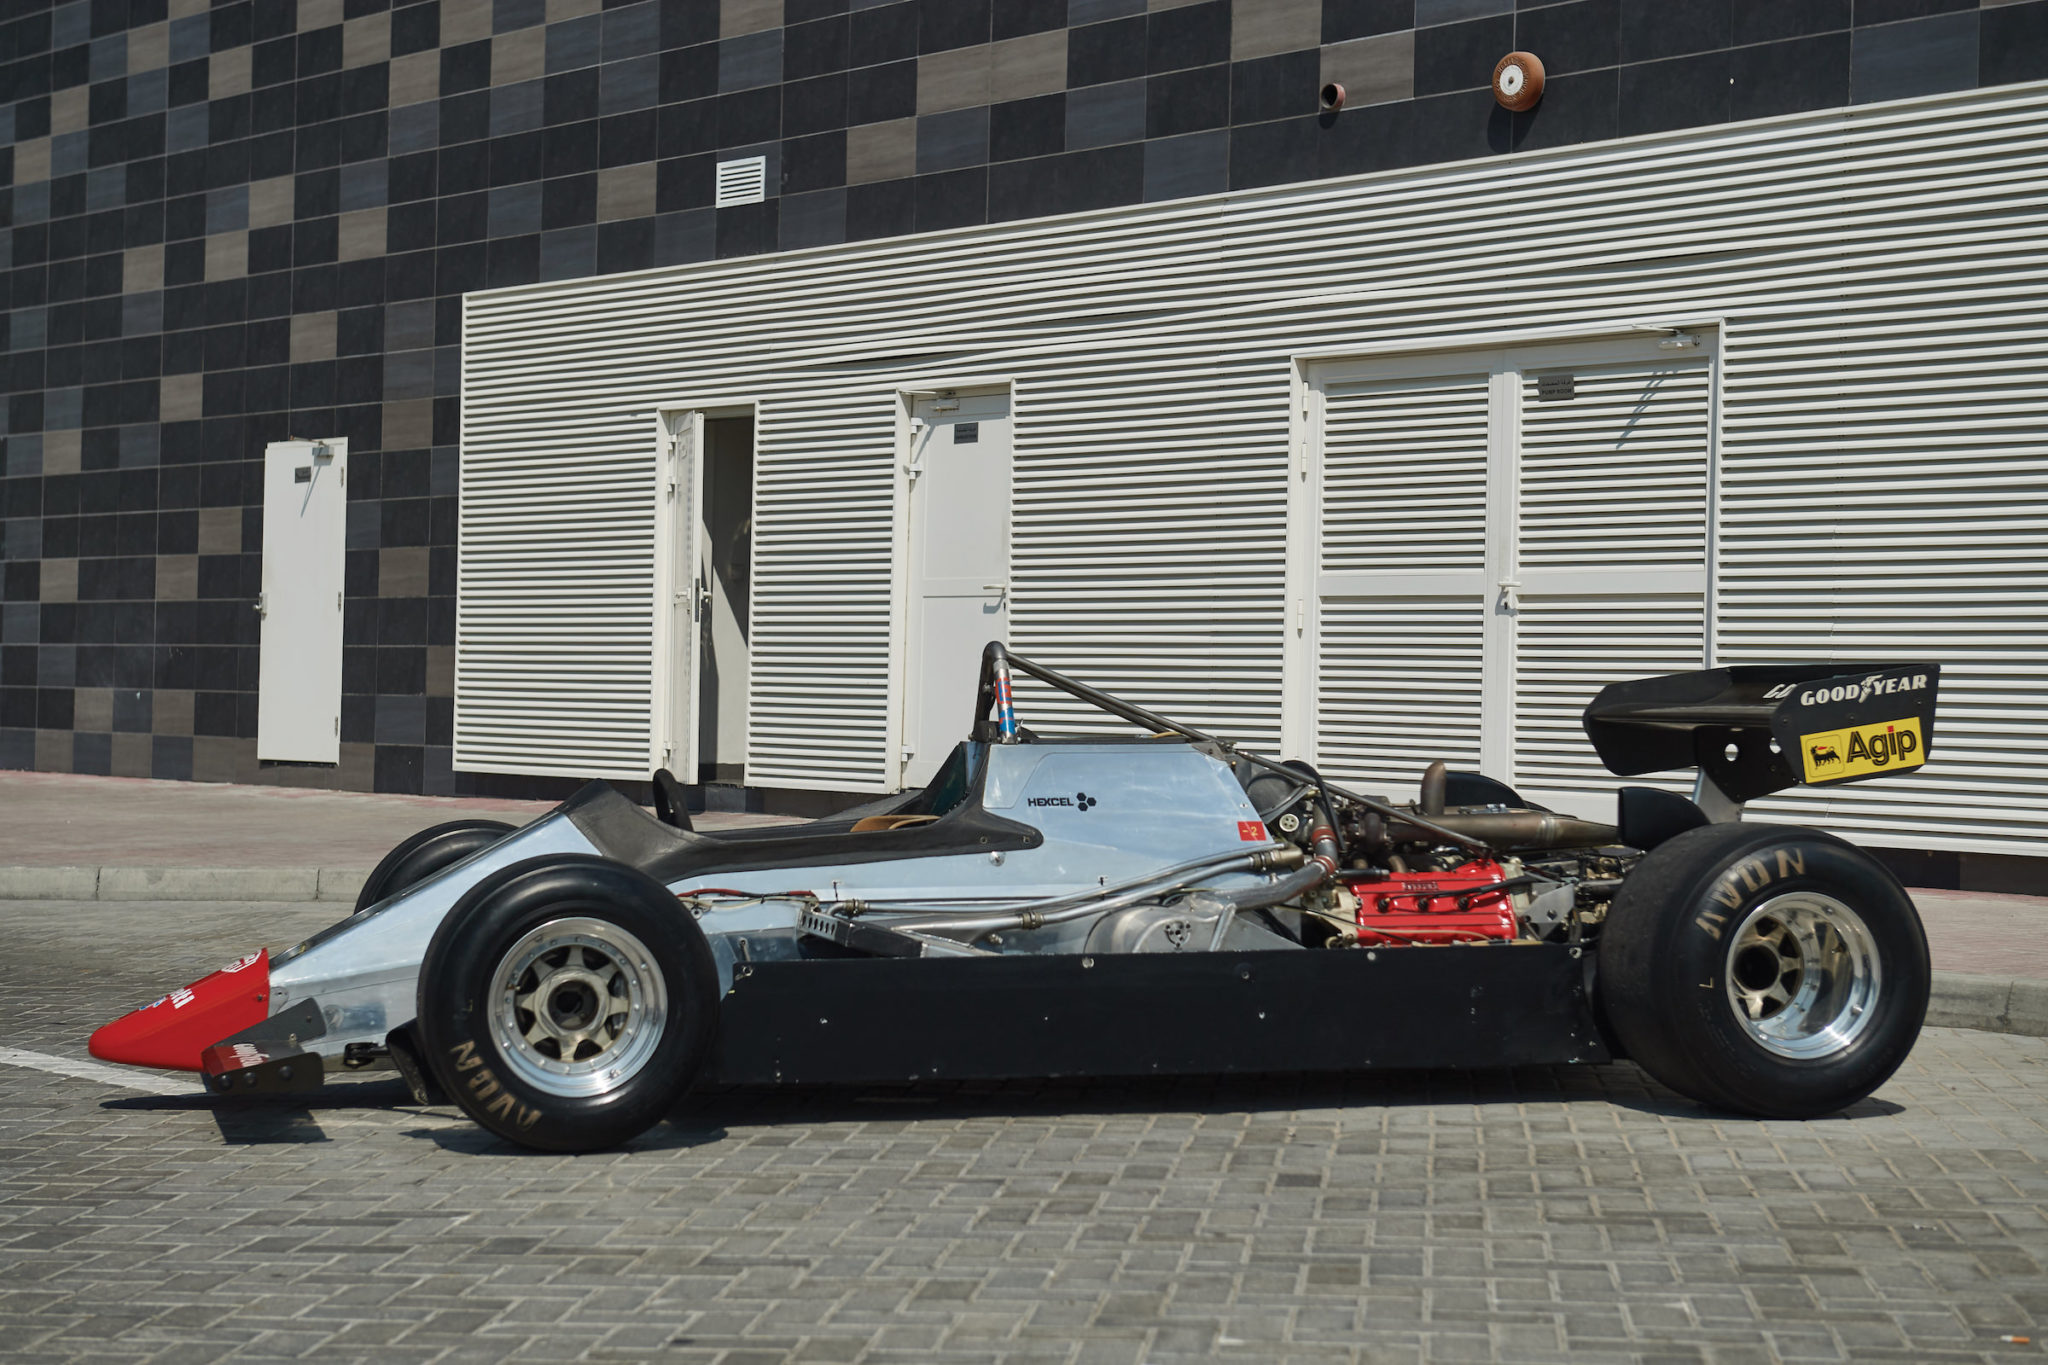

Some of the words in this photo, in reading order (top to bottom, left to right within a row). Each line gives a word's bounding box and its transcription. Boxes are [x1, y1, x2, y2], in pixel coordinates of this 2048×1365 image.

[1800, 674, 1928, 706] GOODYEAR
[1846, 725, 1917, 767] Agip
[1027, 797, 1075, 807] HEXCEL
[1695, 848, 1806, 941] AVON
[449, 1039, 544, 1130] AVON
